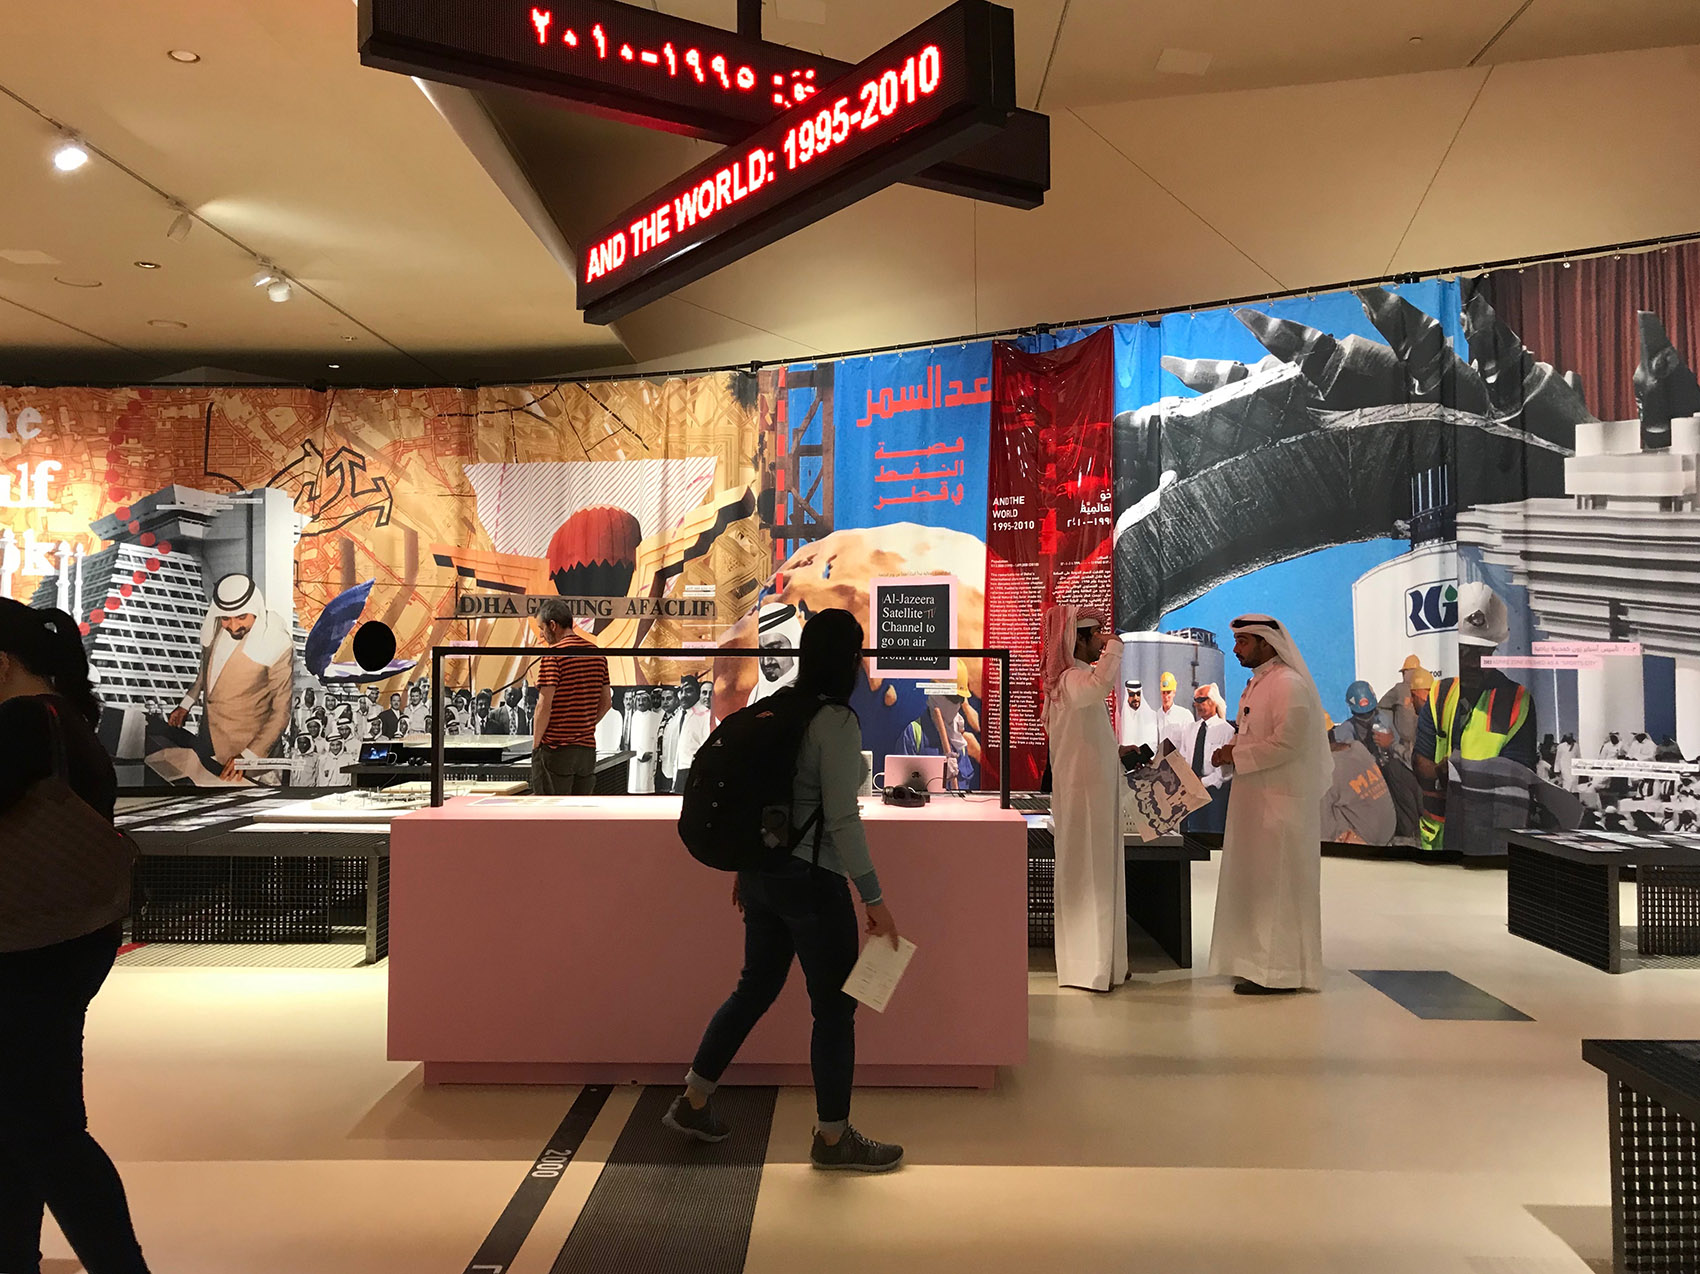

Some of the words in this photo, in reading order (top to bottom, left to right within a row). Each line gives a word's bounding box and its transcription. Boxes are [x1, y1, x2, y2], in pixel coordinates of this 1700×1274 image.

[585, 234, 627, 283] AND
[629, 203, 671, 258] THE
[673, 149, 777, 233] WORLD:
[782, 44, 942, 170] 1995-2010
[875, 460, 964, 482] النفط
[873, 481, 949, 510] قطر
[1010, 495, 1025, 505] THE
[993, 509, 1018, 518] WORLD
[993, 520, 1035, 531] 1995-2010
[883, 593, 935, 605] Al-Jazeera
[882, 607, 923, 619] Satellite
[881, 621, 923, 633] Channel
[926, 624, 936, 633] to
[881, 637, 894, 648] go
[897, 638, 910, 647] on
[913, 636, 926, 647] air
[531, 1149, 572, 1178] 2000
